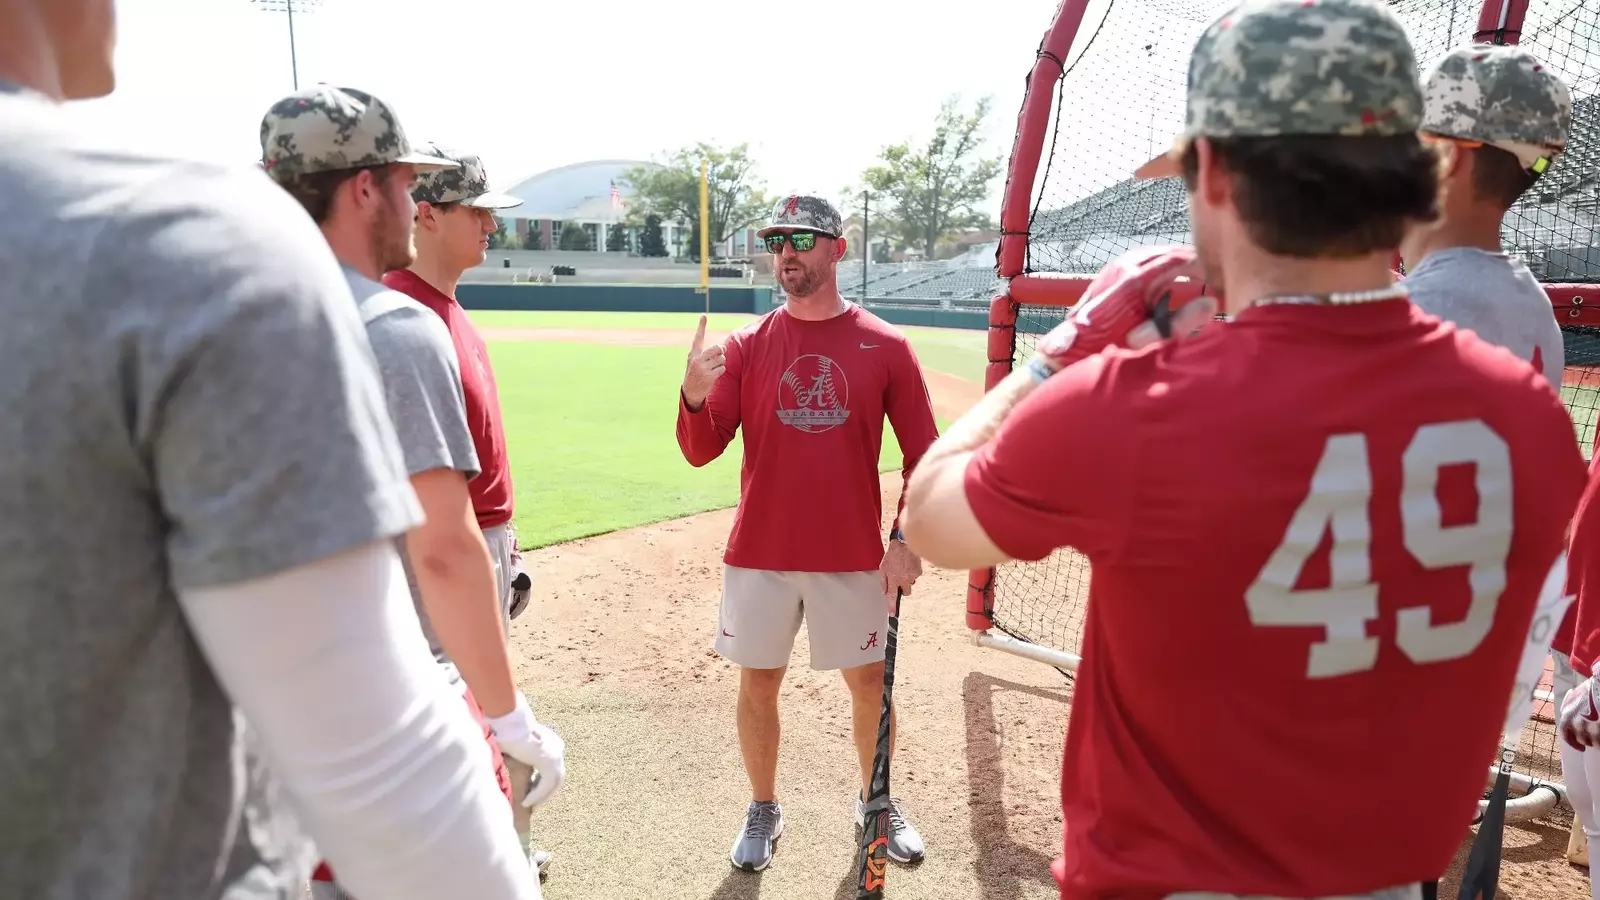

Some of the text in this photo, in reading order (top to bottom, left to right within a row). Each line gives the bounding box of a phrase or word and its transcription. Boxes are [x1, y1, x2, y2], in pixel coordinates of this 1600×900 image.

[778, 195, 798, 218] A
[797, 374, 828, 407] A
[784, 410, 843, 418] ALABAMA
[1244, 418, 1513, 678] 49
[860, 631, 878, 650] A
